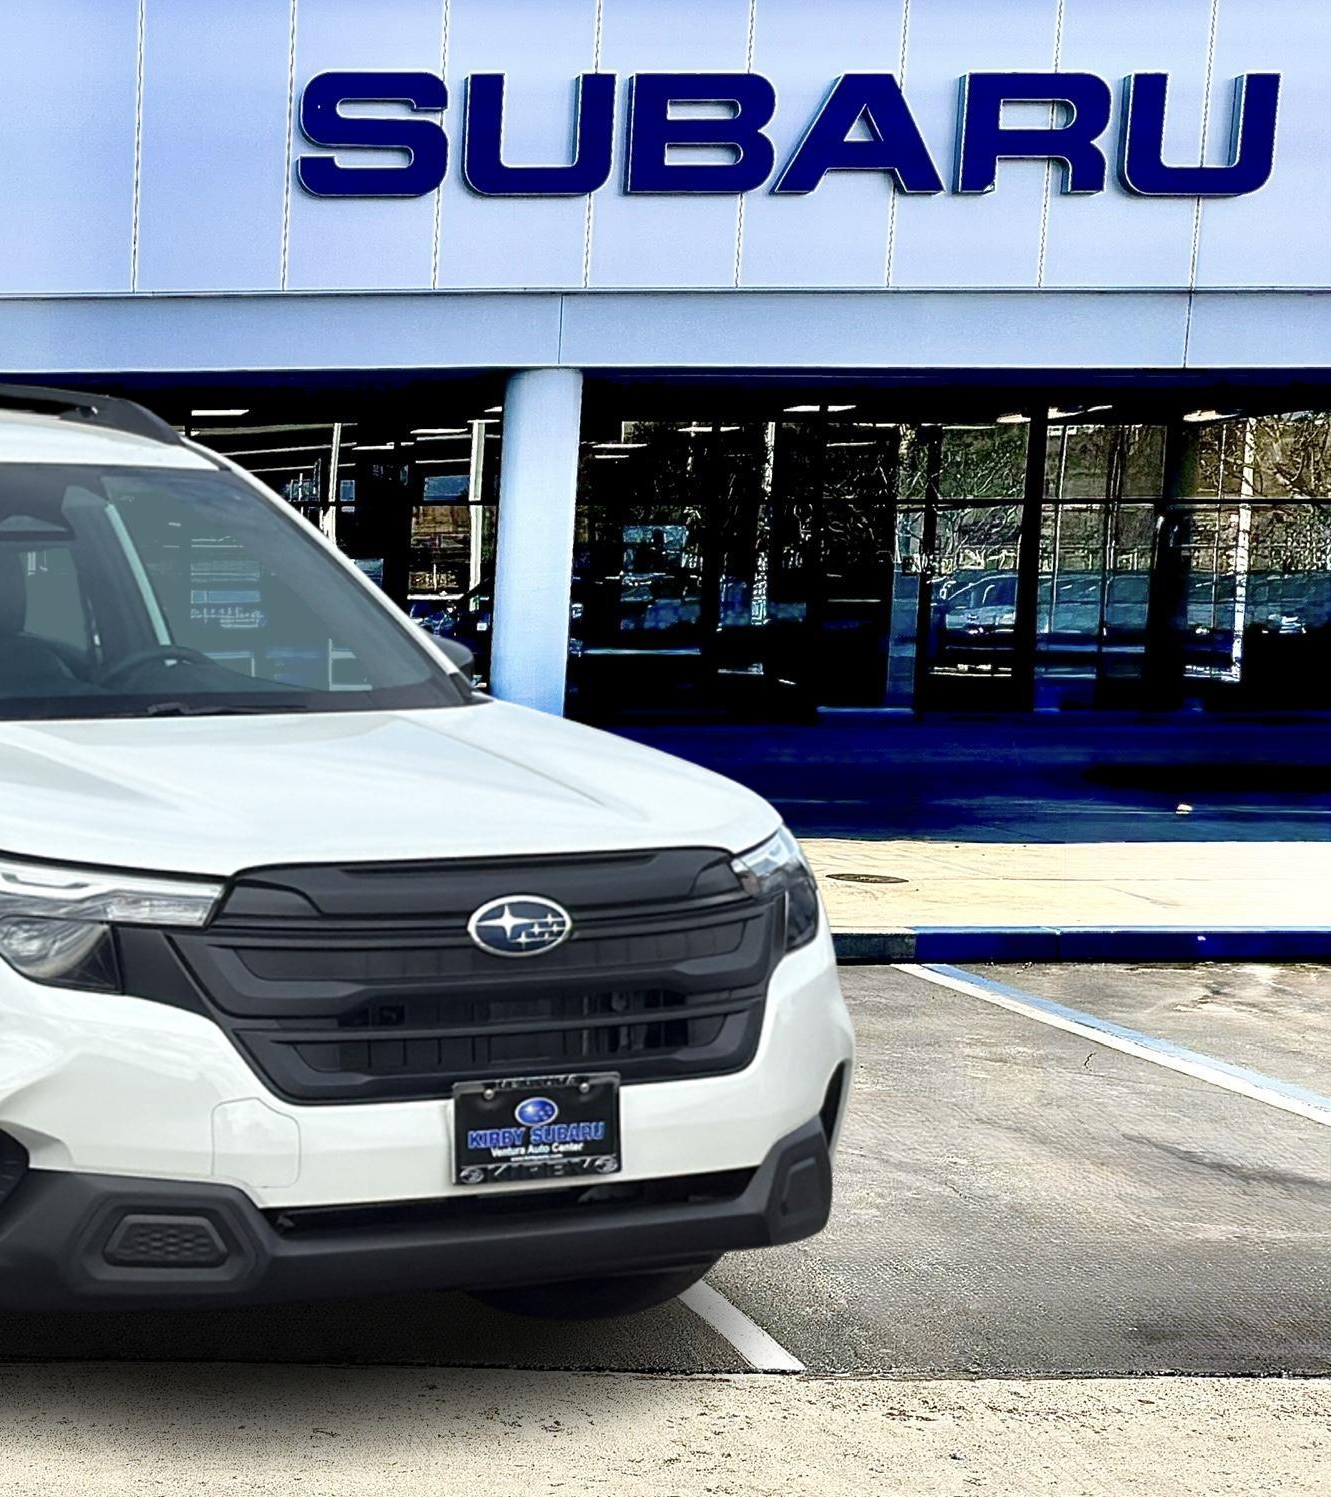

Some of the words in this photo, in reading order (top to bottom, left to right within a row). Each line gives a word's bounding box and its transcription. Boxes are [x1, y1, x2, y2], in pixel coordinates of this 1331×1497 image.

[295, 70, 1281, 200] SUBARU
[468, 1128, 525, 1148] KIRBY
[531, 1122, 604, 1143] SUBARU
[491, 1147, 526, 1157] Ventura
[527, 1144, 551, 1155] Auto
[551, 1141, 584, 1153] Center
